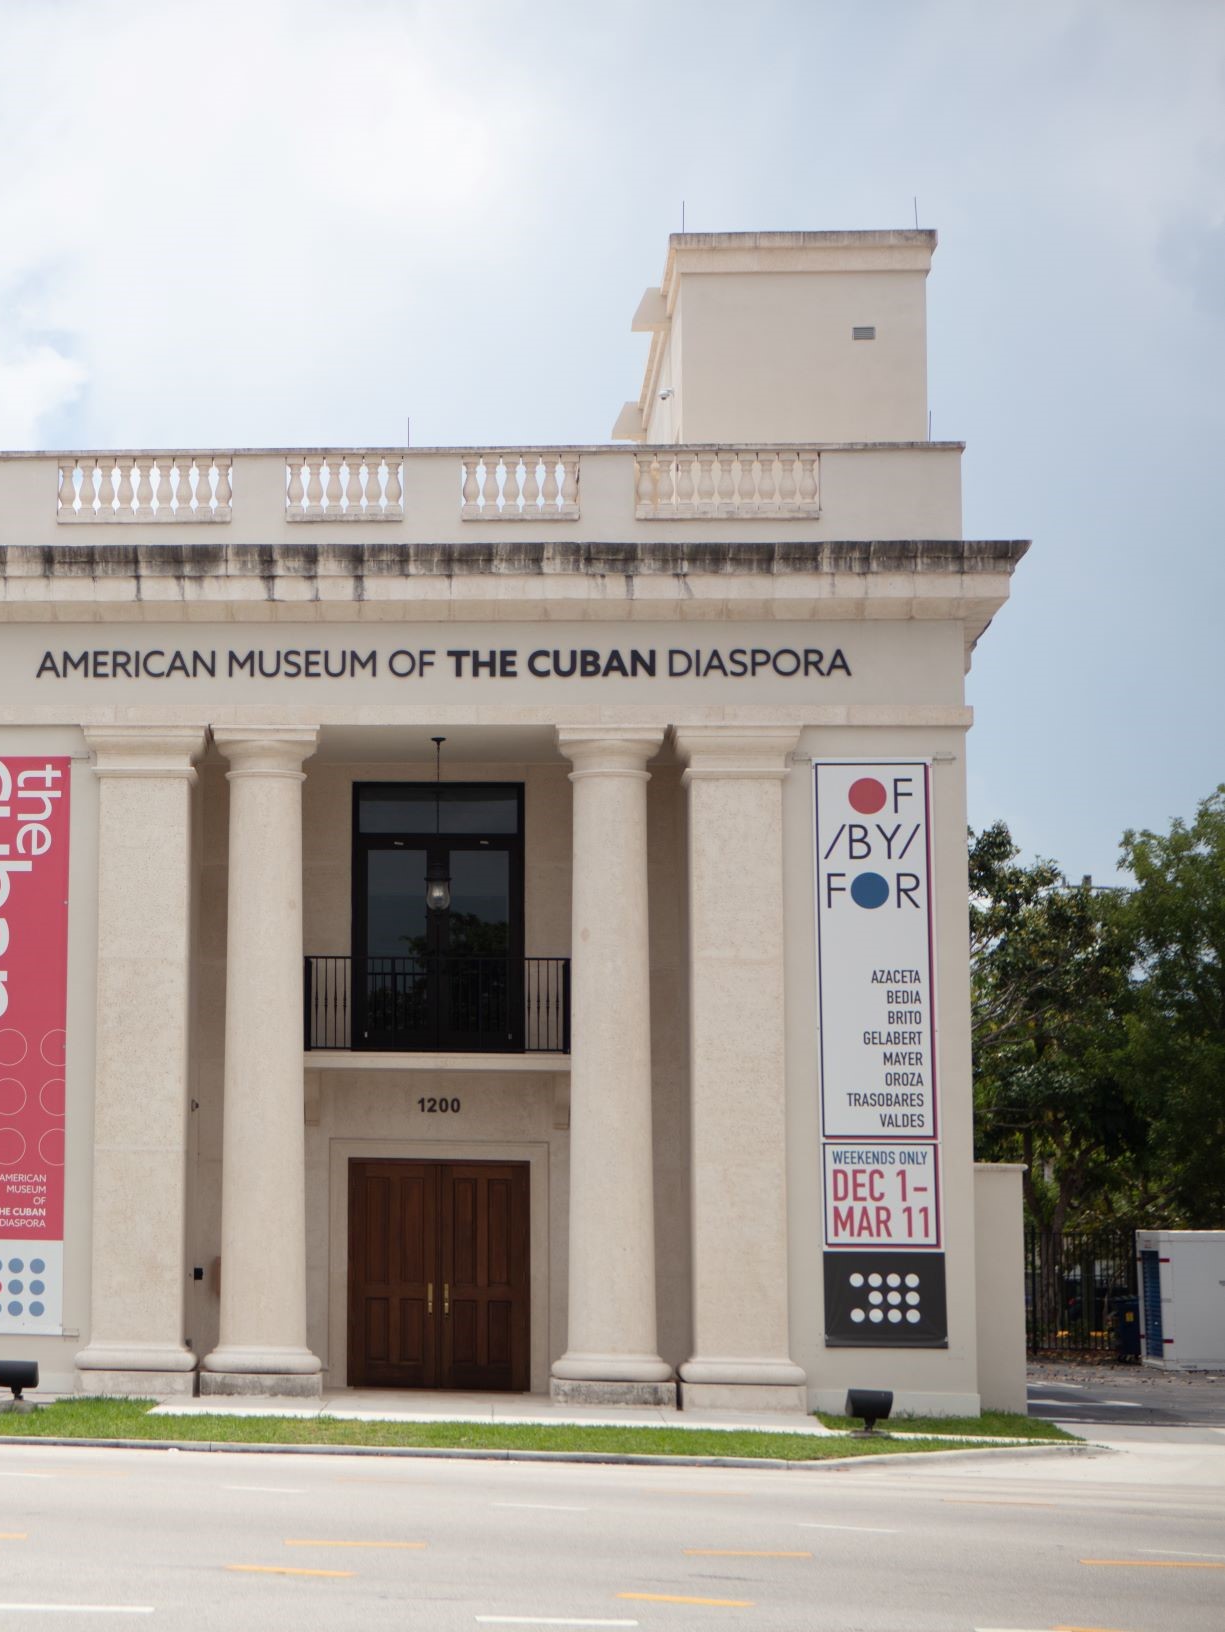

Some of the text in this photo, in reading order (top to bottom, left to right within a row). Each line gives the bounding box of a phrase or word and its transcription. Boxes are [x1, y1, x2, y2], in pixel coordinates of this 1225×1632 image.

[36, 648, 853, 678] AMERICAN MUSEUM OF THE CUBAN DIASPORA
[16, 764, 62, 856] the
[871, 969, 921, 984] AZACETA
[886, 990, 922, 1004] BEDIA
[888, 1010, 922, 1025] BRITO
[863, 1031, 923, 1046] GELABERT
[883, 1051, 923, 1066] MAYER
[885, 1072, 924, 1087] OROZA
[417, 1097, 461, 1113] 1200
[847, 1092, 925, 1107] TRASOBARES
[879, 1113, 925, 1128] VALDES
[832, 1151, 928, 1166] WEEKENDS ONLY
[6, 1185, 47, 1194] MUSEUM
[832, 1169, 885, 1202] DEC
[33, 1196, 46, 1205] OF
[12, 1207, 46, 1217] CUBAN
[0, 1218, 46, 1228] DIASPORA
[833, 1206, 930, 1238] MAR 11
